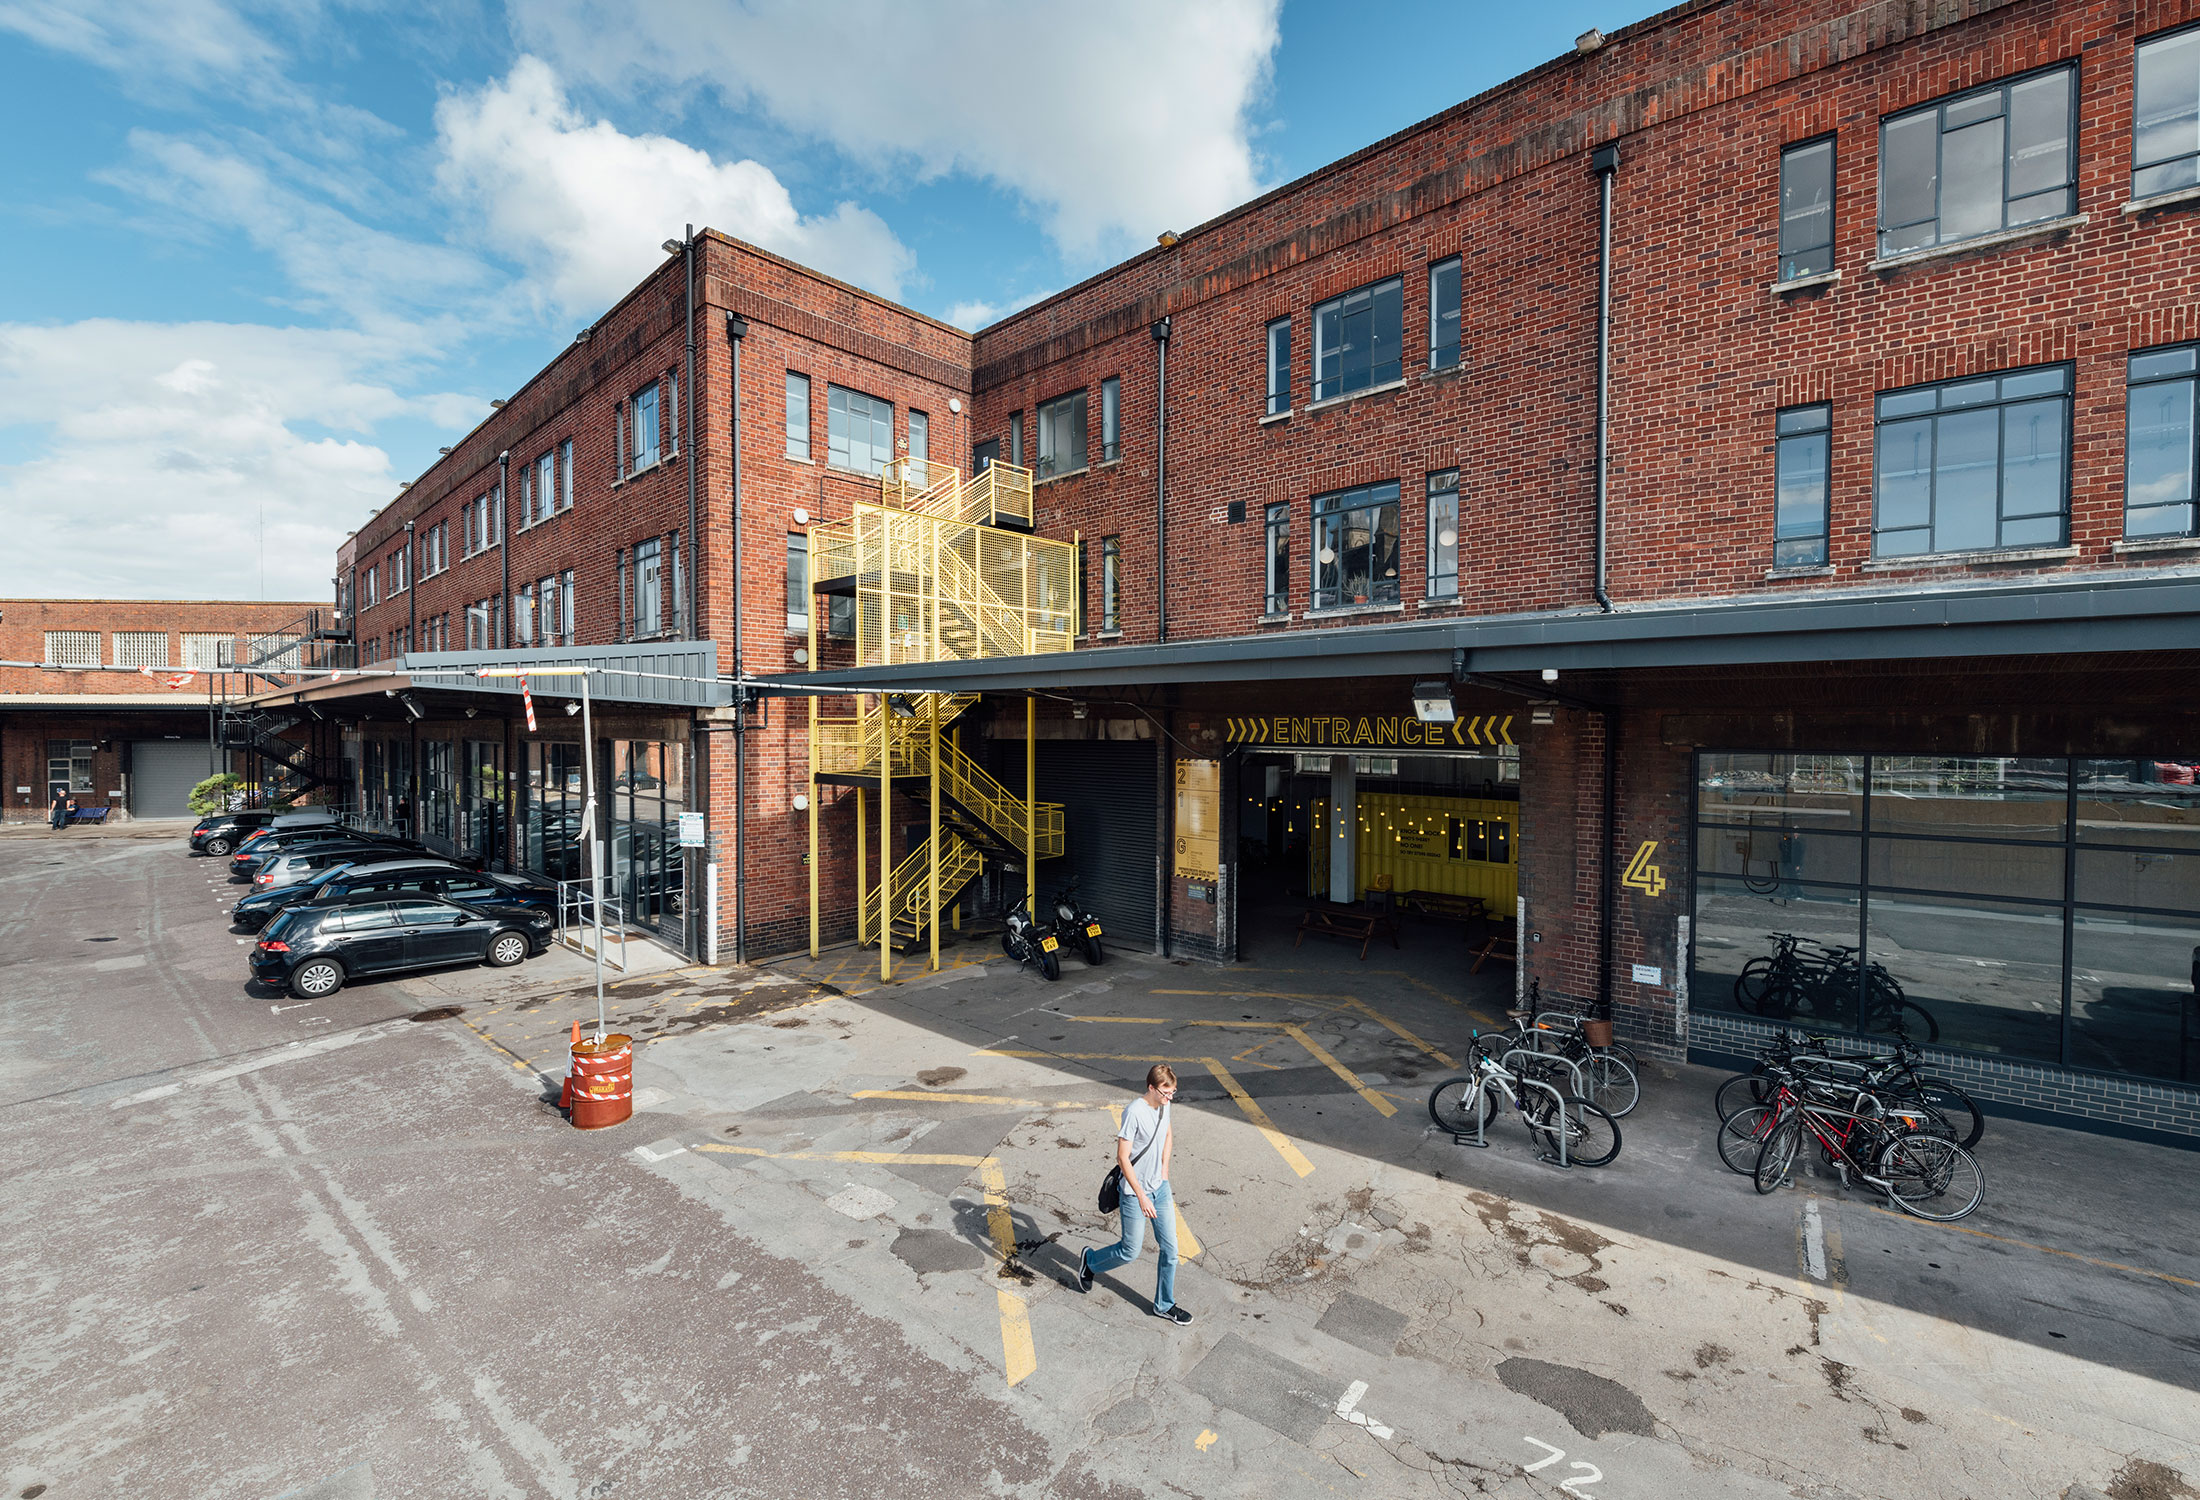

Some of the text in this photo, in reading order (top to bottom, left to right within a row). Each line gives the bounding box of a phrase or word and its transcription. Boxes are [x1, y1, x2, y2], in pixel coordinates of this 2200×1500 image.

[1273, 716, 1445, 745] ENTRANCE
[1177, 768, 1186, 784] 2
[1177, 838, 1186, 854] G
[1622, 841, 1666, 896] 4
[1523, 1436, 1603, 1500] 72
